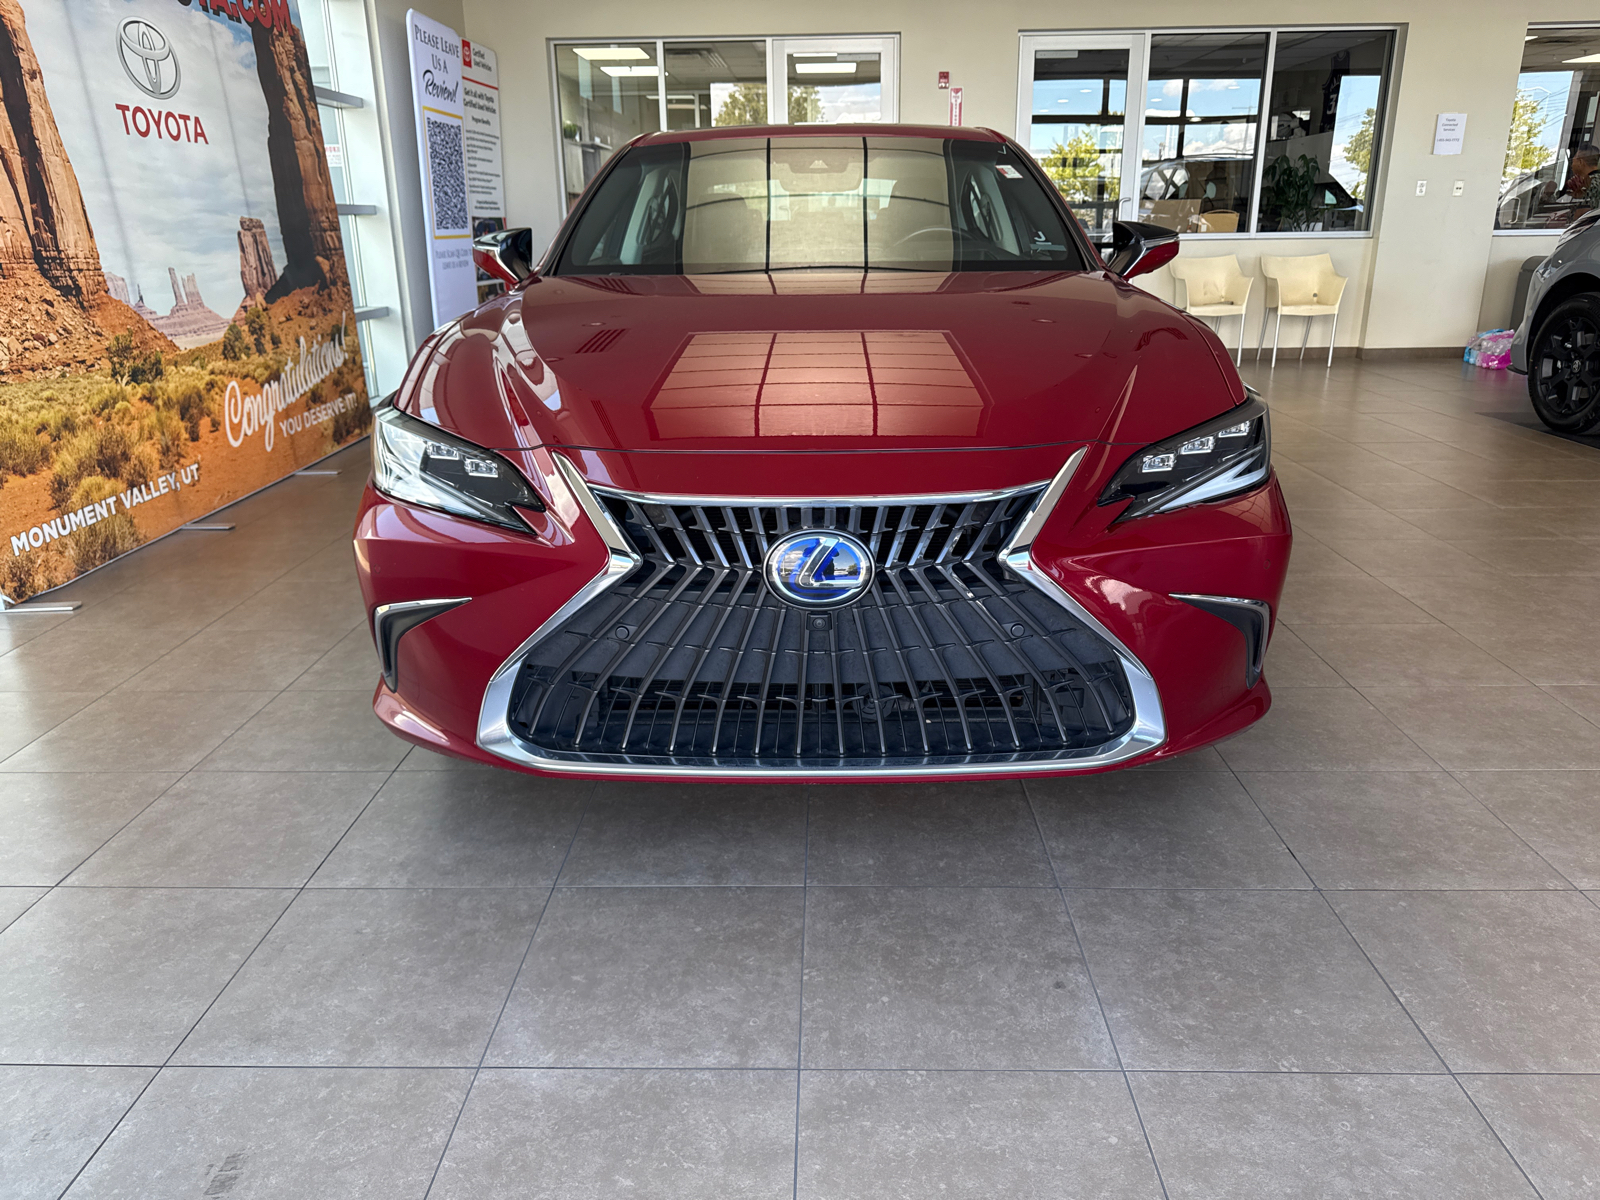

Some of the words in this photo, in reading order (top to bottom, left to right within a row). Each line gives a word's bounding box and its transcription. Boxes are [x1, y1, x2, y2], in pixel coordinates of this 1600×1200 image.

[414, 24, 440, 50] PLEASE
[440, 37, 460, 58] LEAVE
[422, 69, 459, 103] Review!
[442, 59, 449, 74] A
[115, 103, 209, 145] TOYOTA
[225, 310, 349, 452] Congratulations!
[279, 413, 303, 438] YOU
[303, 398, 347, 428] DESERVE
[345, 392, 358, 413] IT!
[10, 495, 117, 557] MONUMENT
[120, 471, 182, 510] VALLEY,
[180, 463, 200, 485] UT
